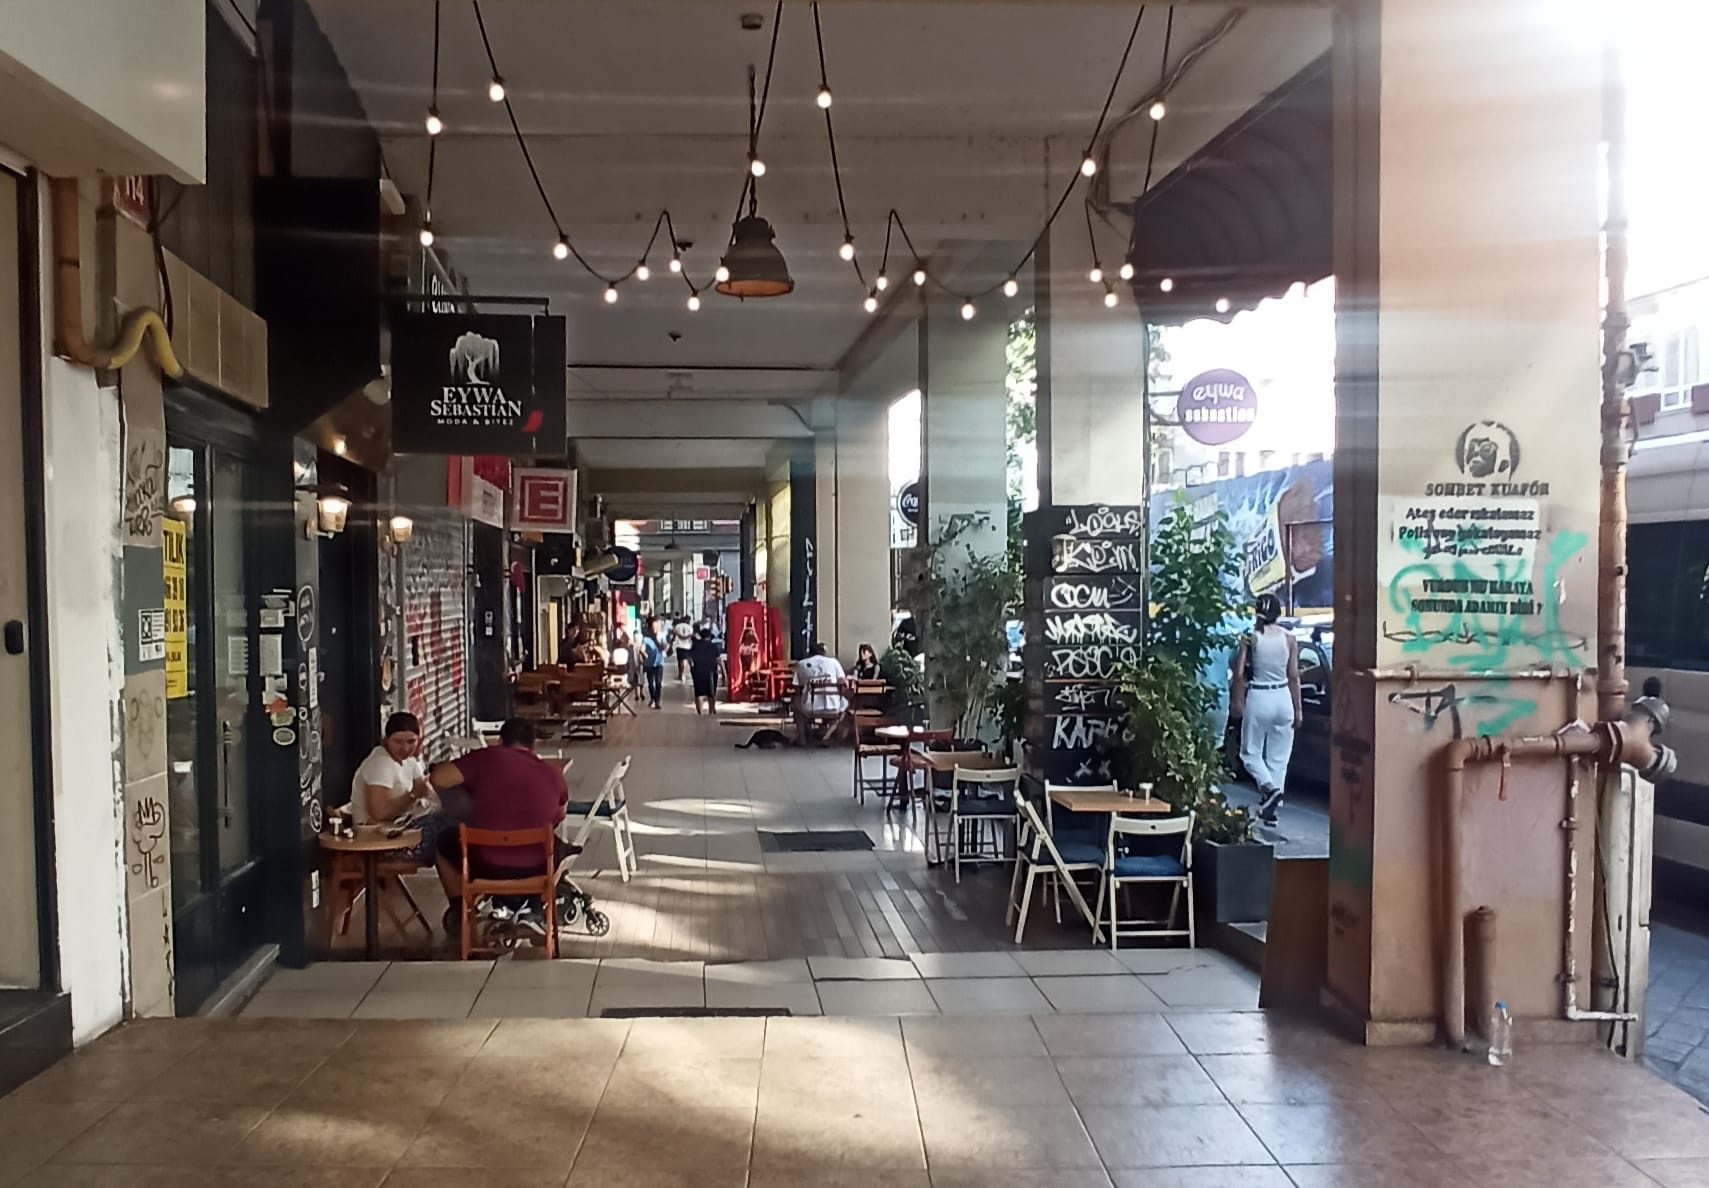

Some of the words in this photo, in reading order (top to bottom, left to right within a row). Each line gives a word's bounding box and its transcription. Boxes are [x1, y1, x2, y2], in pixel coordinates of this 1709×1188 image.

[442, 386, 506, 404] EYWA
[1193, 383, 1246, 405] eywa
[1425, 482, 1486, 497] SOHBET
[1490, 480, 1550, 496] KUAFÖR
[526, 481, 562, 518] E
